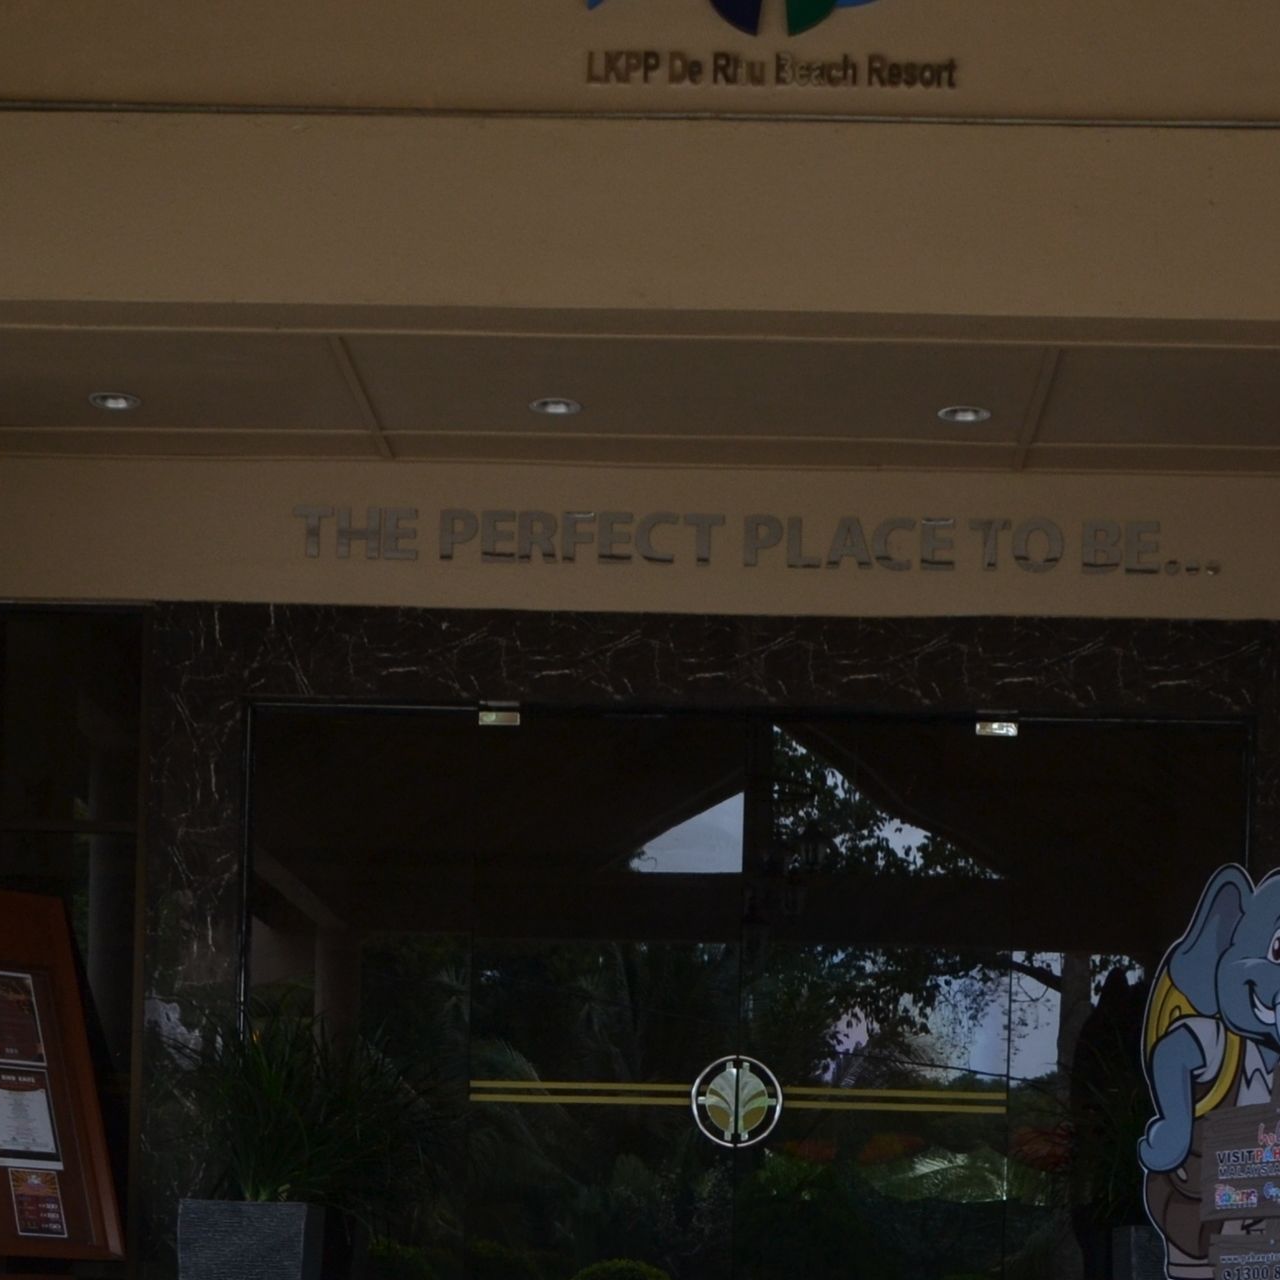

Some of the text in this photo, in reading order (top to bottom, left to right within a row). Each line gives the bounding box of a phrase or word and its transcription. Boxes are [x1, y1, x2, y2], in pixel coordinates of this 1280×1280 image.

[586, 51, 659, 84] LKPP
[667, 51, 702, 84] De
[775, 51, 857, 86] Beach
[867, 54, 958, 88] Resort
[295, 506, 1222, 577] THE PERFECT PLACE TO BE...
[1234, 1266, 1269, 1280] 1300
